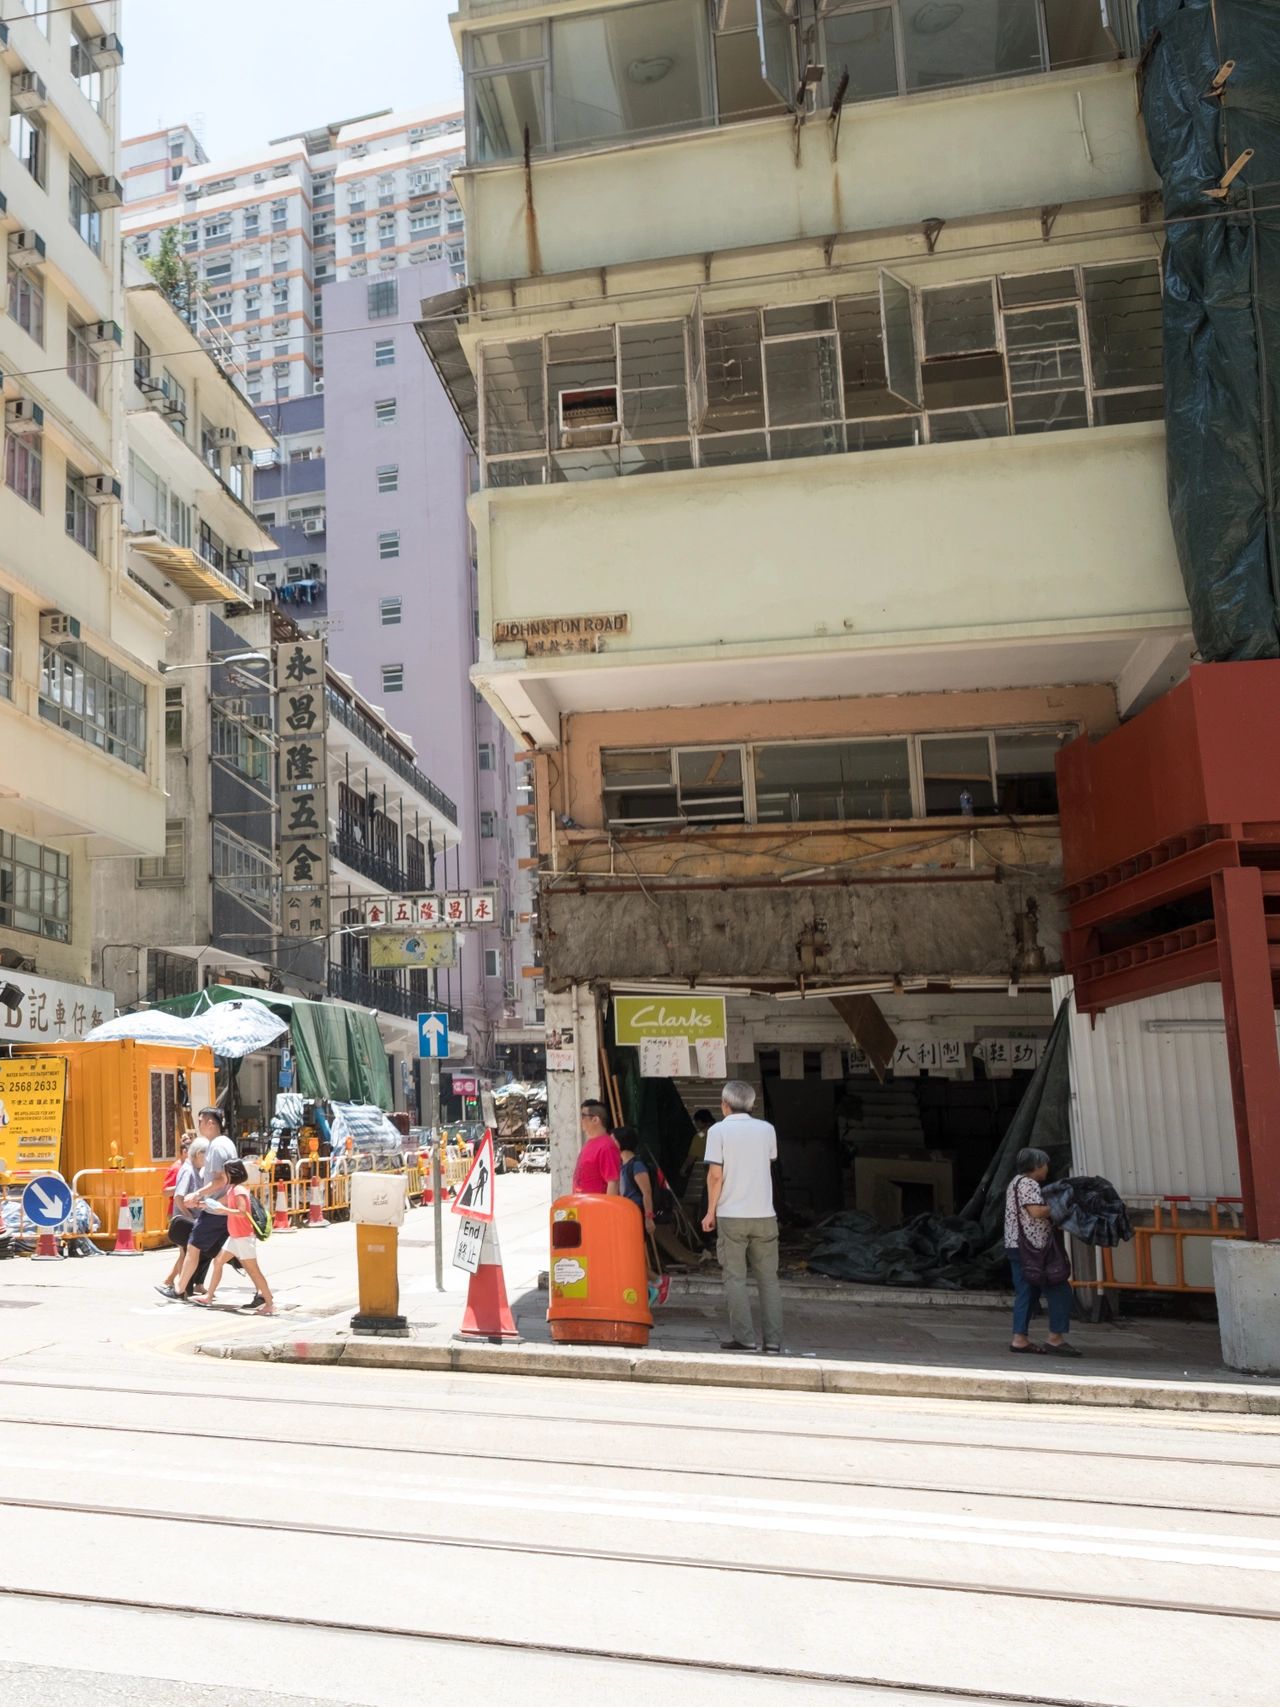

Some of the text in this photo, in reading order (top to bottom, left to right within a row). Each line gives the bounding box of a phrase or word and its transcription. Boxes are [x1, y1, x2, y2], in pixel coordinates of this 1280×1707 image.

[504, 616, 624, 636] JOHNSTON ROAD
[630, 1005, 713, 1028] Clarks
[282, 1050, 291, 1069] P
[9, 1080, 57, 1092] 2568 2633
[463, 1221, 481, 1239] End
